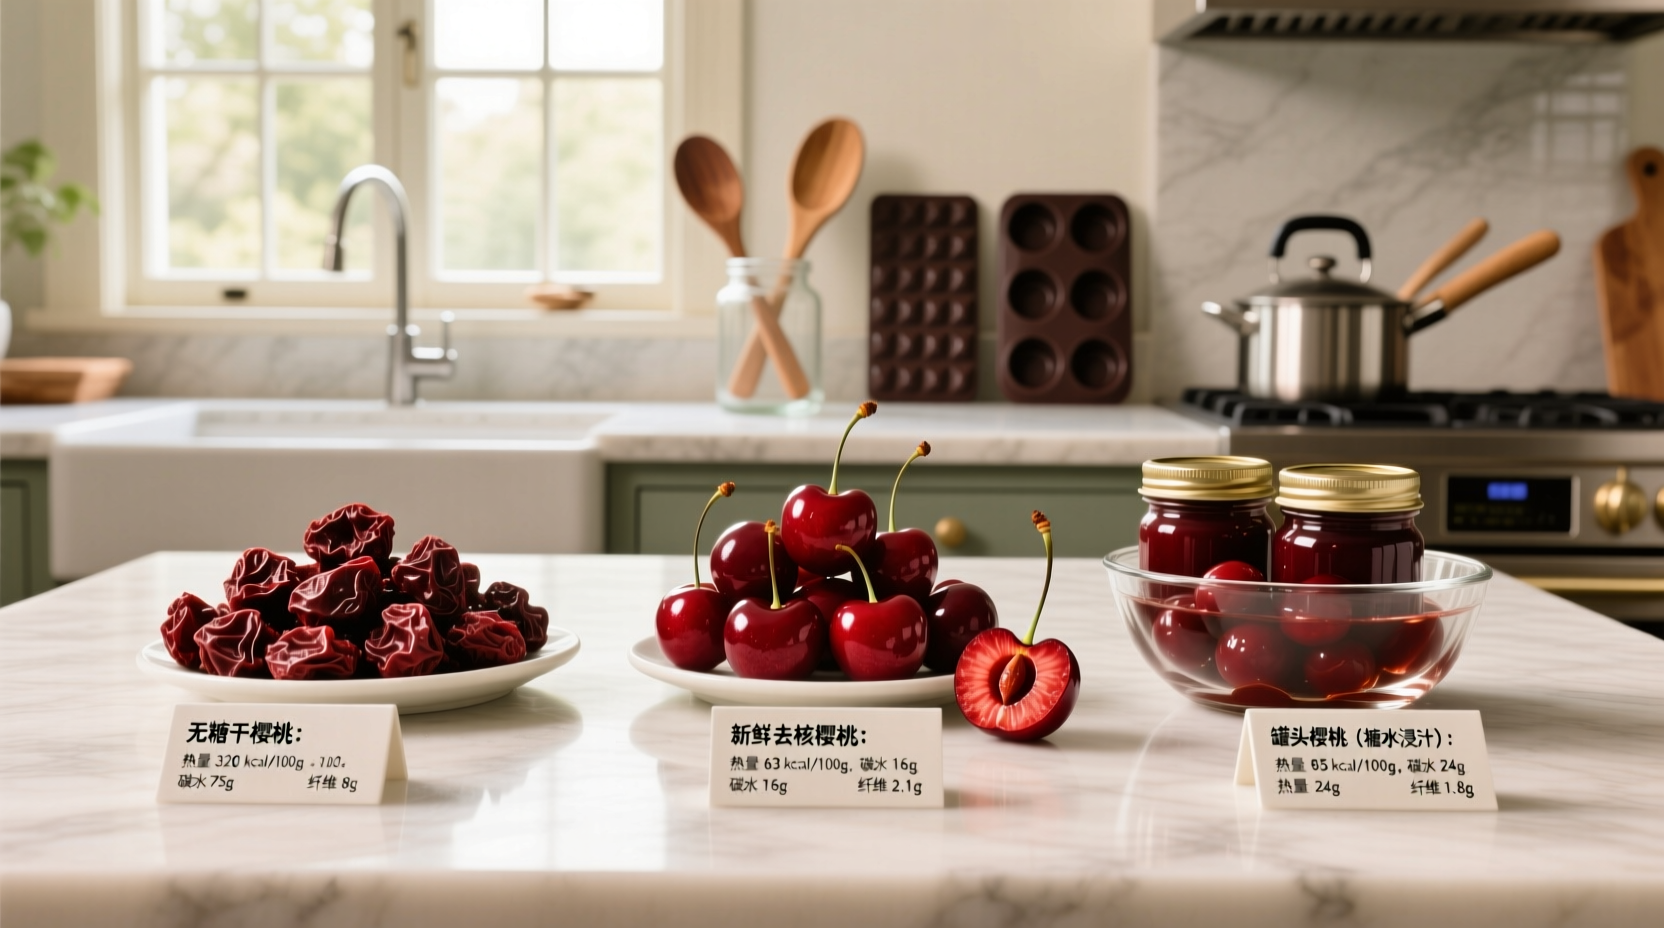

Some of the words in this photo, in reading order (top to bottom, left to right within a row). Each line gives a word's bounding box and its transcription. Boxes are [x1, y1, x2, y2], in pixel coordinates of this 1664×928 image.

[214, 754, 241, 769] 320
[729, 755, 760, 772] 热量
[763, 756, 781, 771] 63
[892, 757, 919, 776] 16g
[1439, 758, 1466, 777] 24g
[209, 774, 235, 792] 75g
[341, 776, 358, 793] 8g
[762, 778, 788, 796] 16g
[891, 778, 923, 797] 2.1g
[1314, 779, 1341, 798] 24g
[1443, 780, 1475, 800] 1.8g
